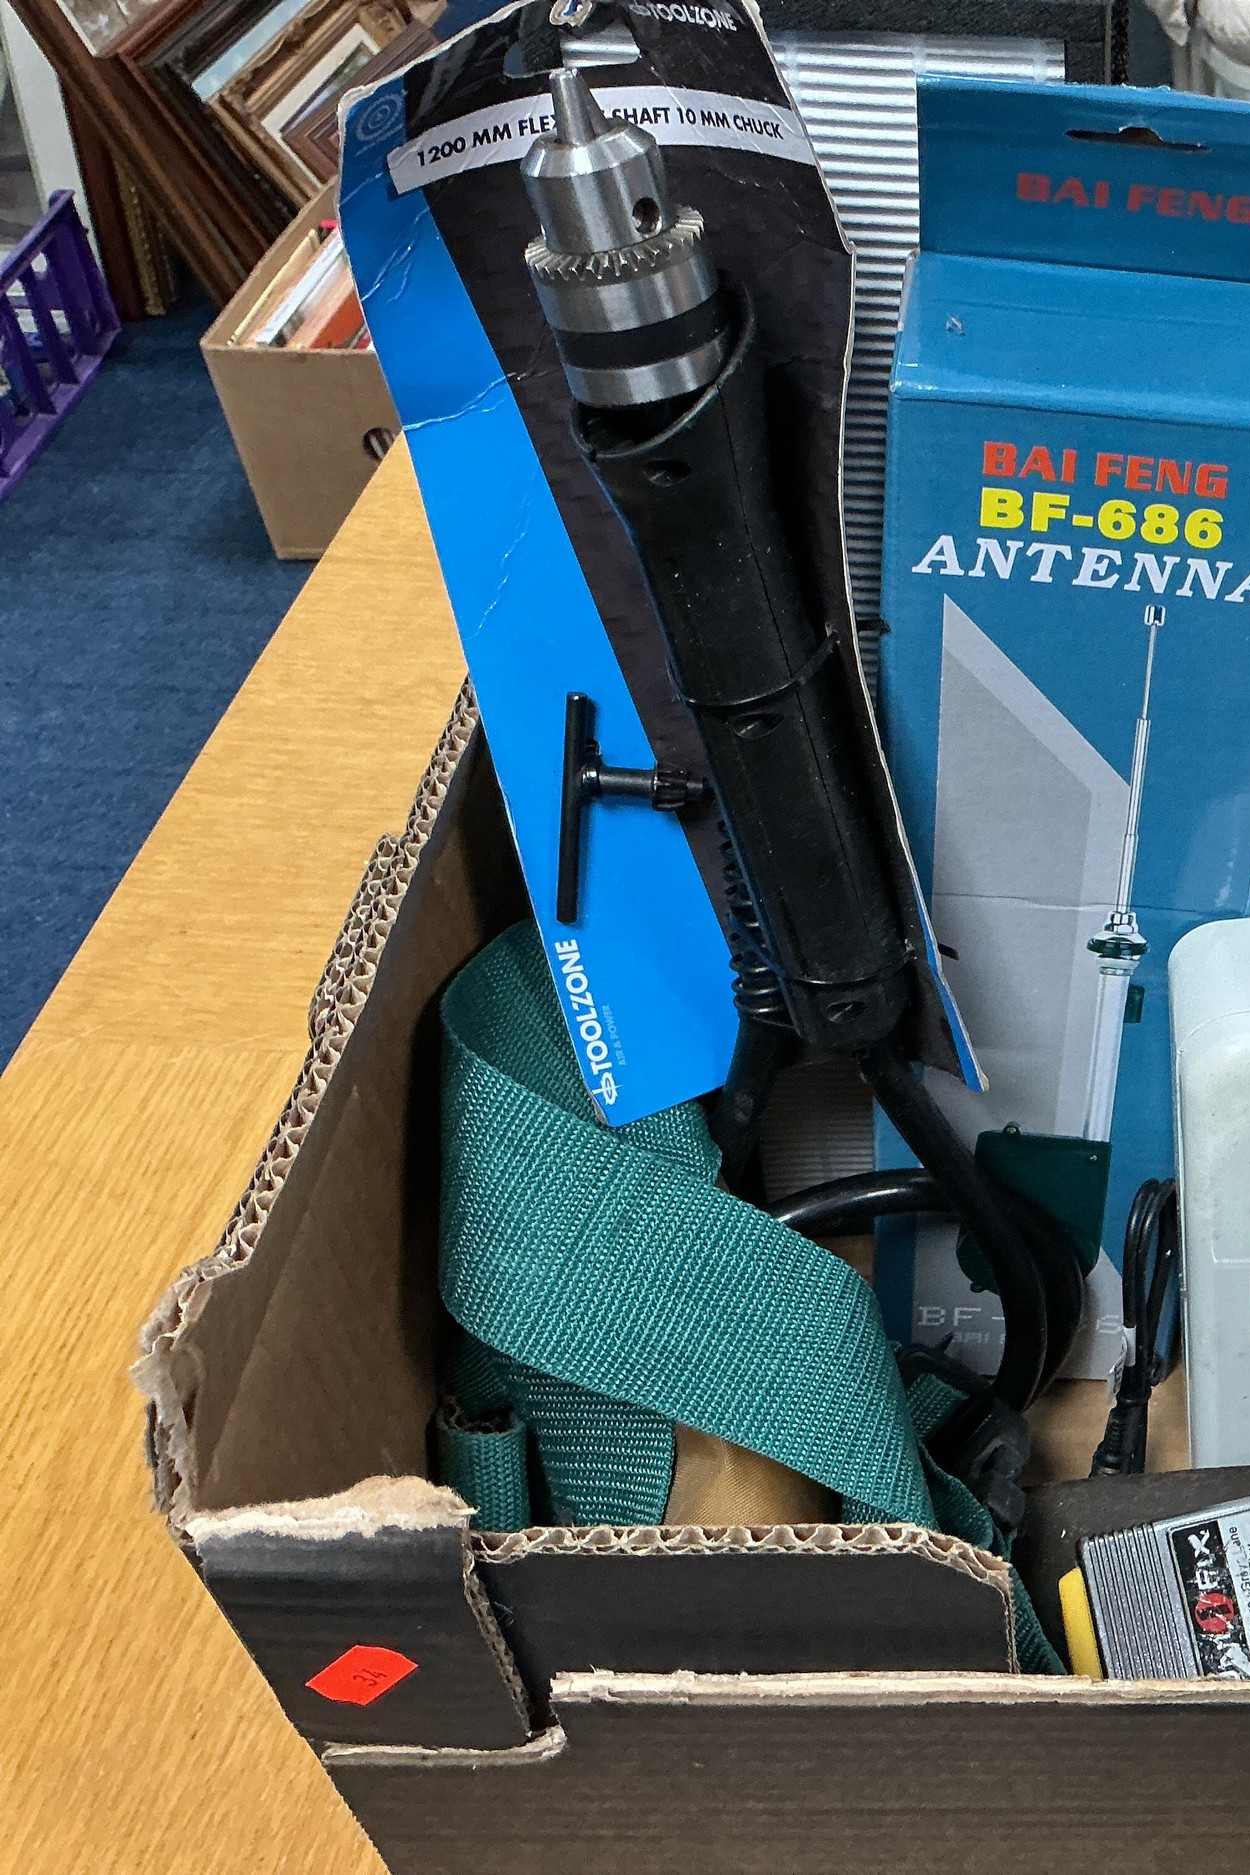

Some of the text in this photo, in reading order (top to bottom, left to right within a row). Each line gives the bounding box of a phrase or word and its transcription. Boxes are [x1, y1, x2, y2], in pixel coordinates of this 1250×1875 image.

[646, 3, 738, 32] TOOLZONE
[417, 136, 467, 167] 1200
[472, 121, 512, 147] MM
[611, 107, 670, 125] SHAFT
[677, 107, 697, 124] 10
[700, 110, 731, 130] MM
[732, 114, 784, 141] CHUCK
[1016, 171, 1110, 210] BAI
[982, 440, 1230, 499] BAI FENG
[979, 486, 1226, 550] BF-686
[554, 938, 613, 1076] TOOLZONE
[353, 1668, 388, 1687] 34
